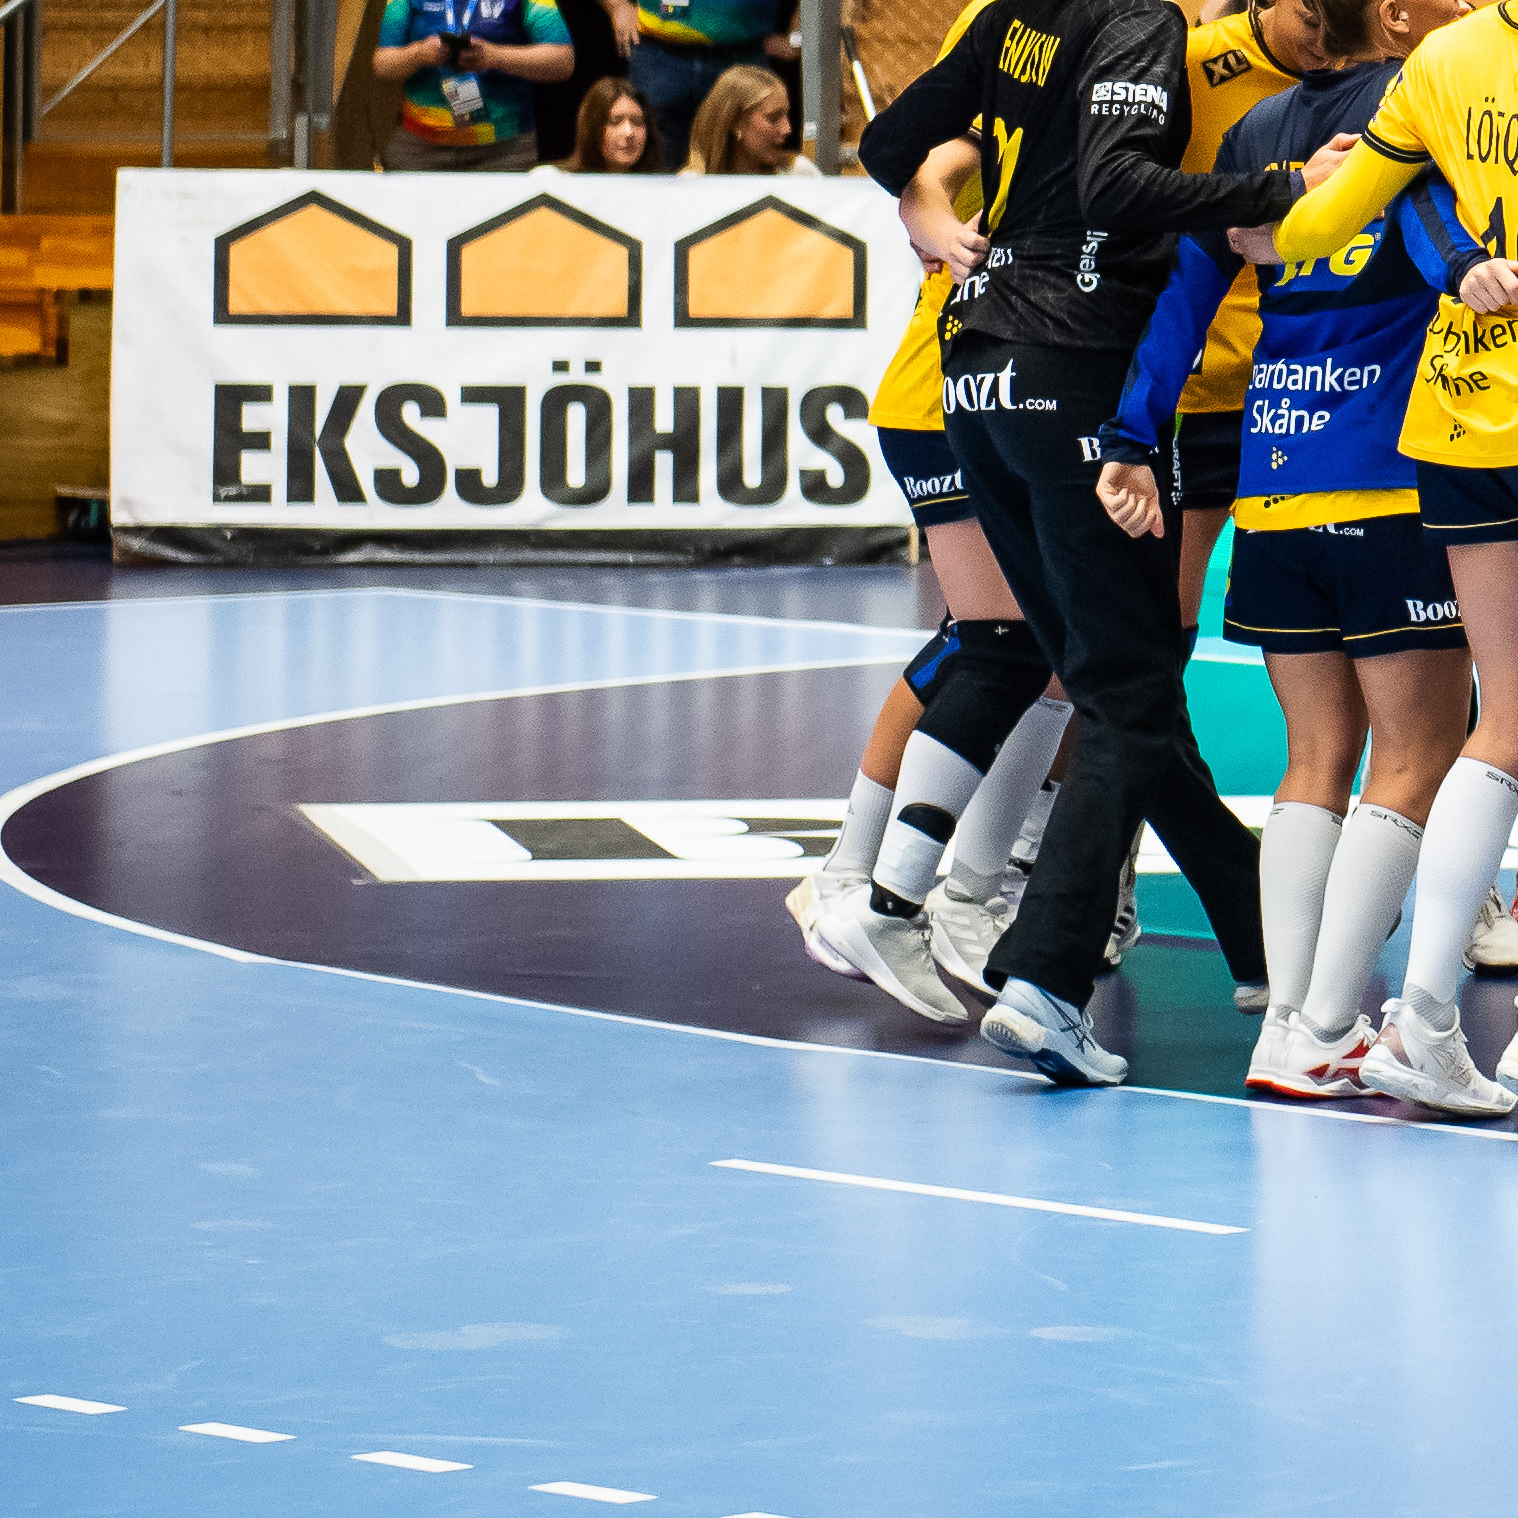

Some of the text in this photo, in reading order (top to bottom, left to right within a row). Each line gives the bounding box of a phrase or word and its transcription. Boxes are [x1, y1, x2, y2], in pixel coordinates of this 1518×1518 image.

[1112, 82, 1168, 113] STENA
[942, 358, 1057, 414] oozt.COM
[1249, 357, 1381, 393] arbanken
[212, 360, 871, 507] EKSJÖHUS
[1250, 397, 1331, 435] Skåne
[1405, 599, 1461, 623] Boo
